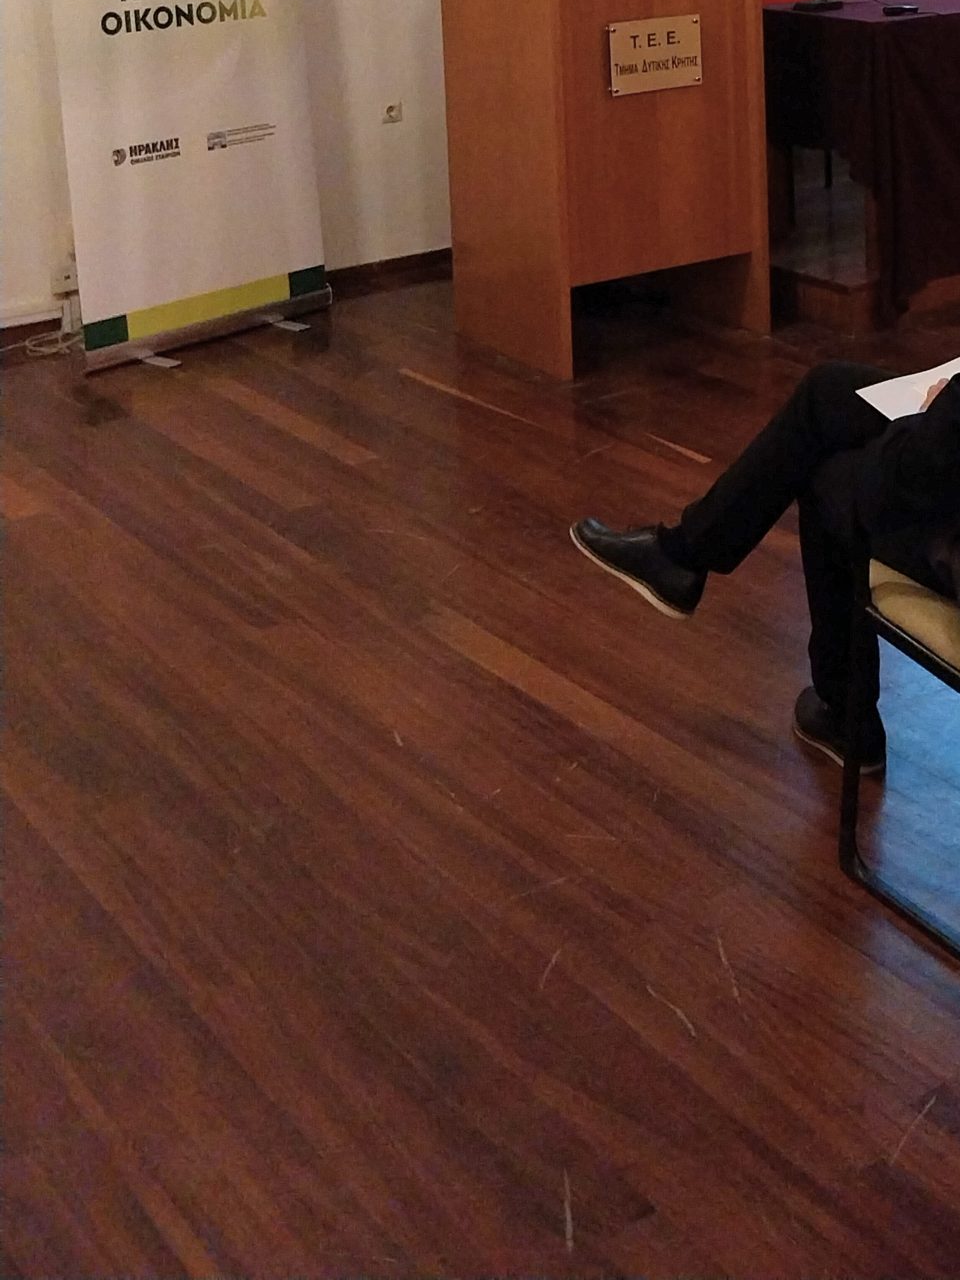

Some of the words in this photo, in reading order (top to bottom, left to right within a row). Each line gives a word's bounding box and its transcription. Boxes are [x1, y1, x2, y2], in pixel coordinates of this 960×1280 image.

[614, 62, 638, 76] ΤΜΗΜΑ
[642, 58, 669, 73] ΔΥΤΙΚΗΣ
[671, 55, 698, 69] ΚΡΗΤΗΣ
[129, 137, 180, 158] ΗΡΑΚΛΗΣ
